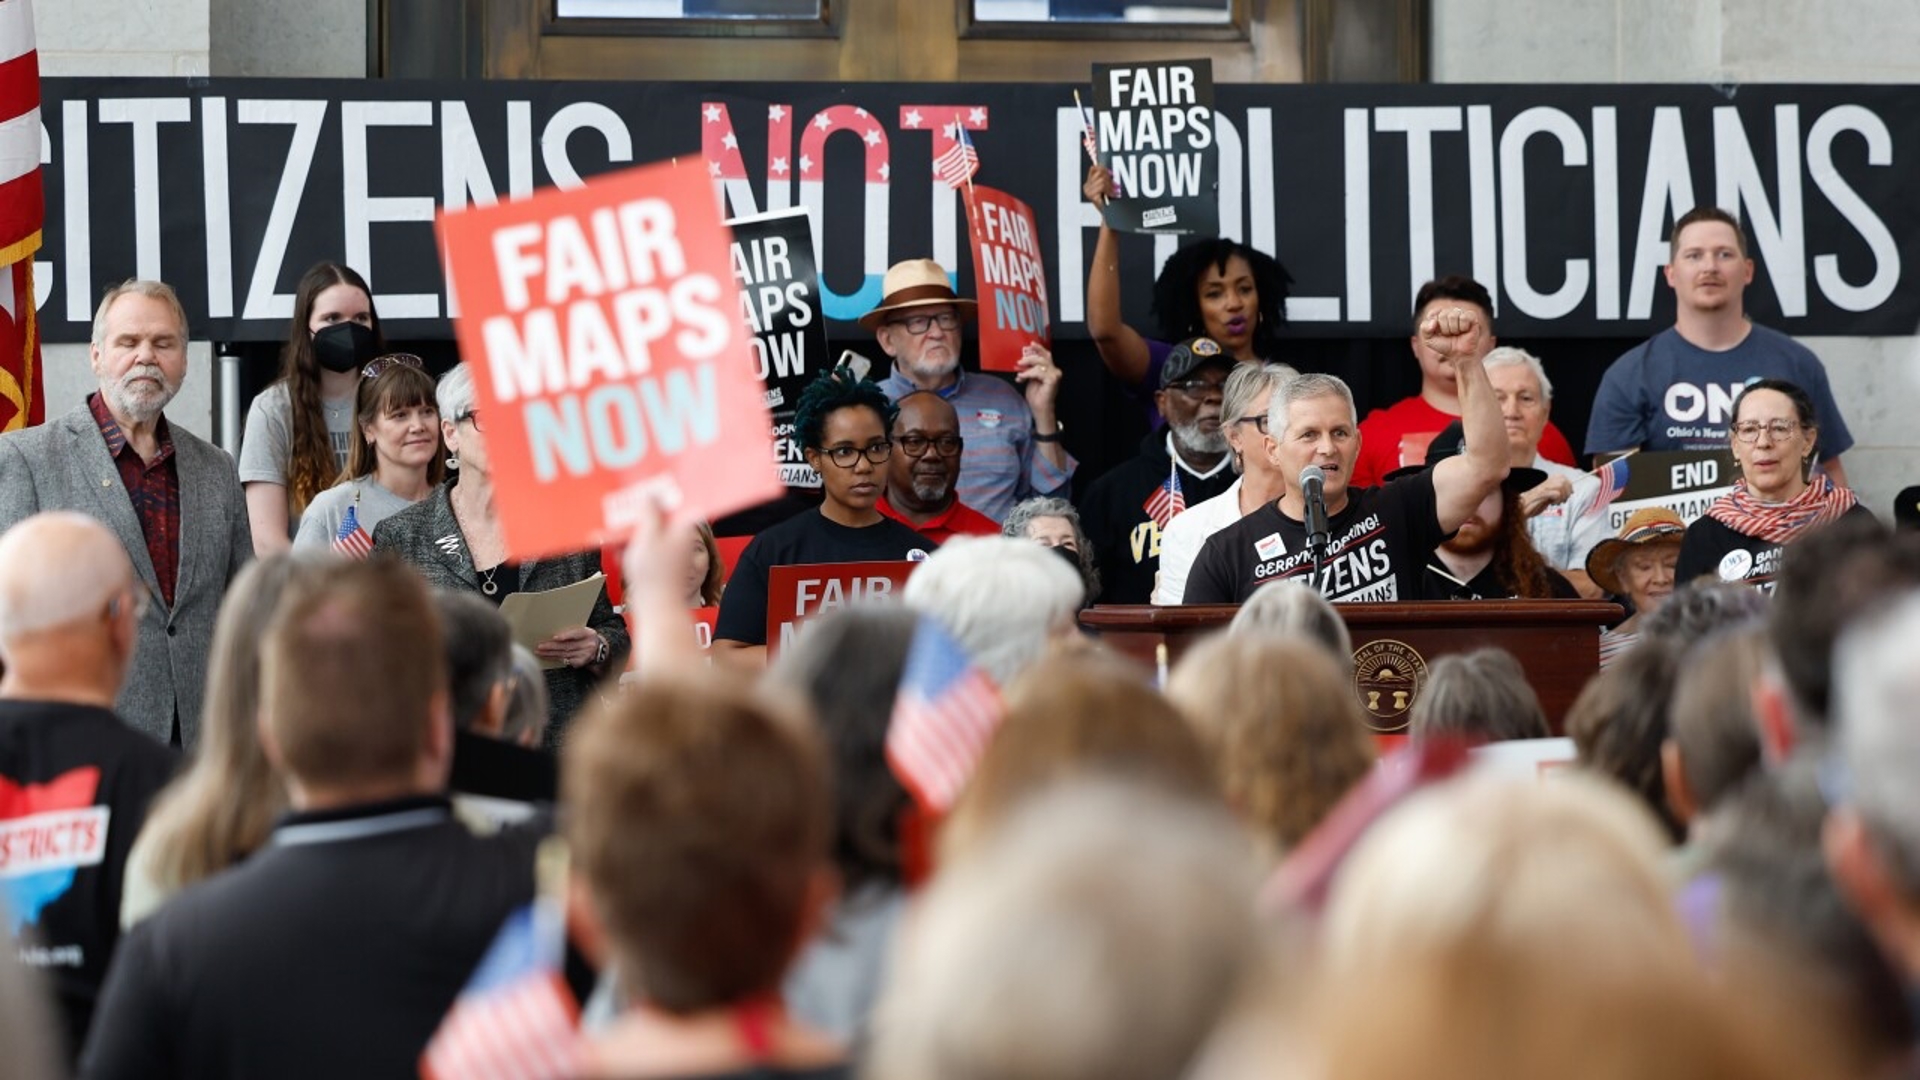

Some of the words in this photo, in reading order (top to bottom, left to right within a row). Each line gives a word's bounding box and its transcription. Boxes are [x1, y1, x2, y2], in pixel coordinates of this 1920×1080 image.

[1110, 66, 1196, 107] FAIR
[1099, 106, 1212, 152] MAPS
[1112, 152, 1202, 199] NOW
[981, 201, 1034, 256] FAIR
[490, 198, 687, 313] FAIR
[980, 243, 1045, 303] MAPS
[480, 273, 731, 405] MAPS
[522, 364, 722, 483] NOW
[1702, 427, 1727, 439] New
[1671, 460, 1718, 490] END
[1756, 547, 1783, 565] BAN
[796, 576, 892, 616] FAIR
[1354, 648, 1373, 667] SEAL
[1374, 643, 1385, 653] OF
[1388, 644, 1406, 655] THE
